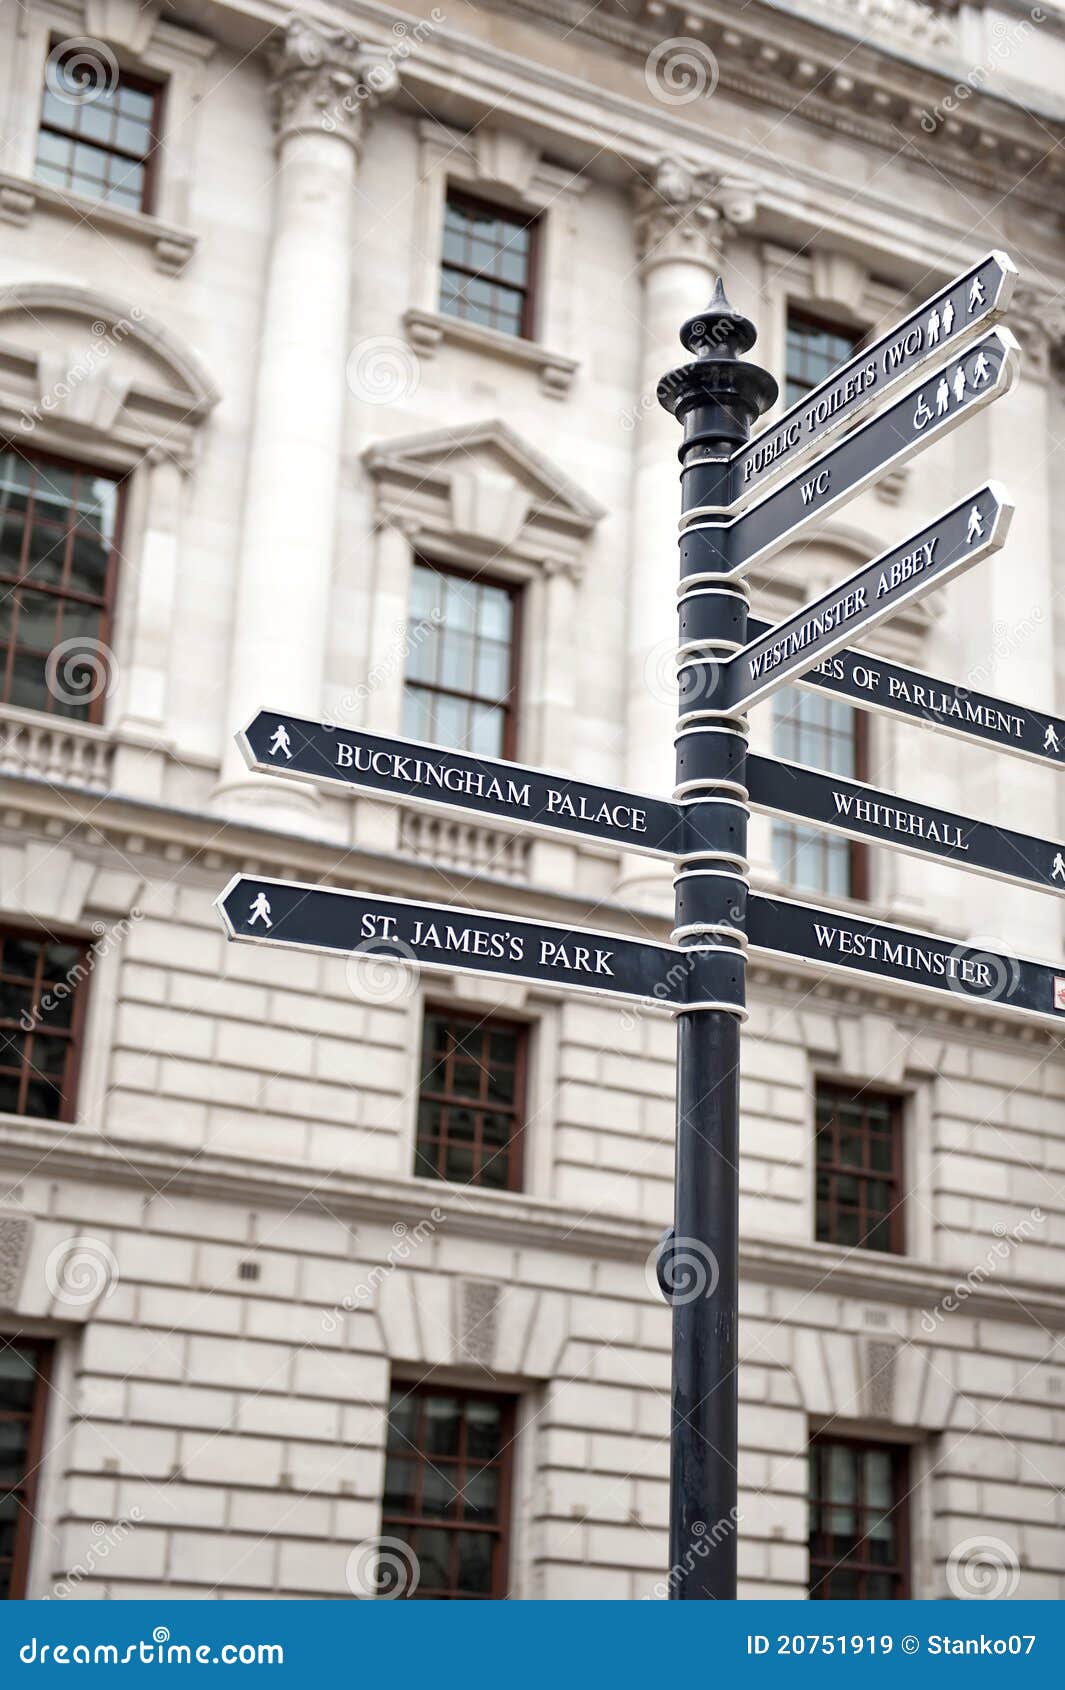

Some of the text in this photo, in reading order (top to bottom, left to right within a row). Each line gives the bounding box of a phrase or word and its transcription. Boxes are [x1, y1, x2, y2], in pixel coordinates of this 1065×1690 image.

[743, 326, 925, 482] PUBLIC TOILETS (WC)
[799, 470, 831, 506] WC
[748, 537, 939, 681] WESTMINSTER ABBEY
[852, 666, 880, 690] OF
[888, 677, 1025, 738] PARLIAMENT
[335, 743, 647, 834] BUCKINGHAM PALACE
[832, 791, 969, 850] WHITEHALL
[360, 913, 614, 977] ST. JAMES'S PARK
[813, 923, 993, 987] WESTMINSTER
